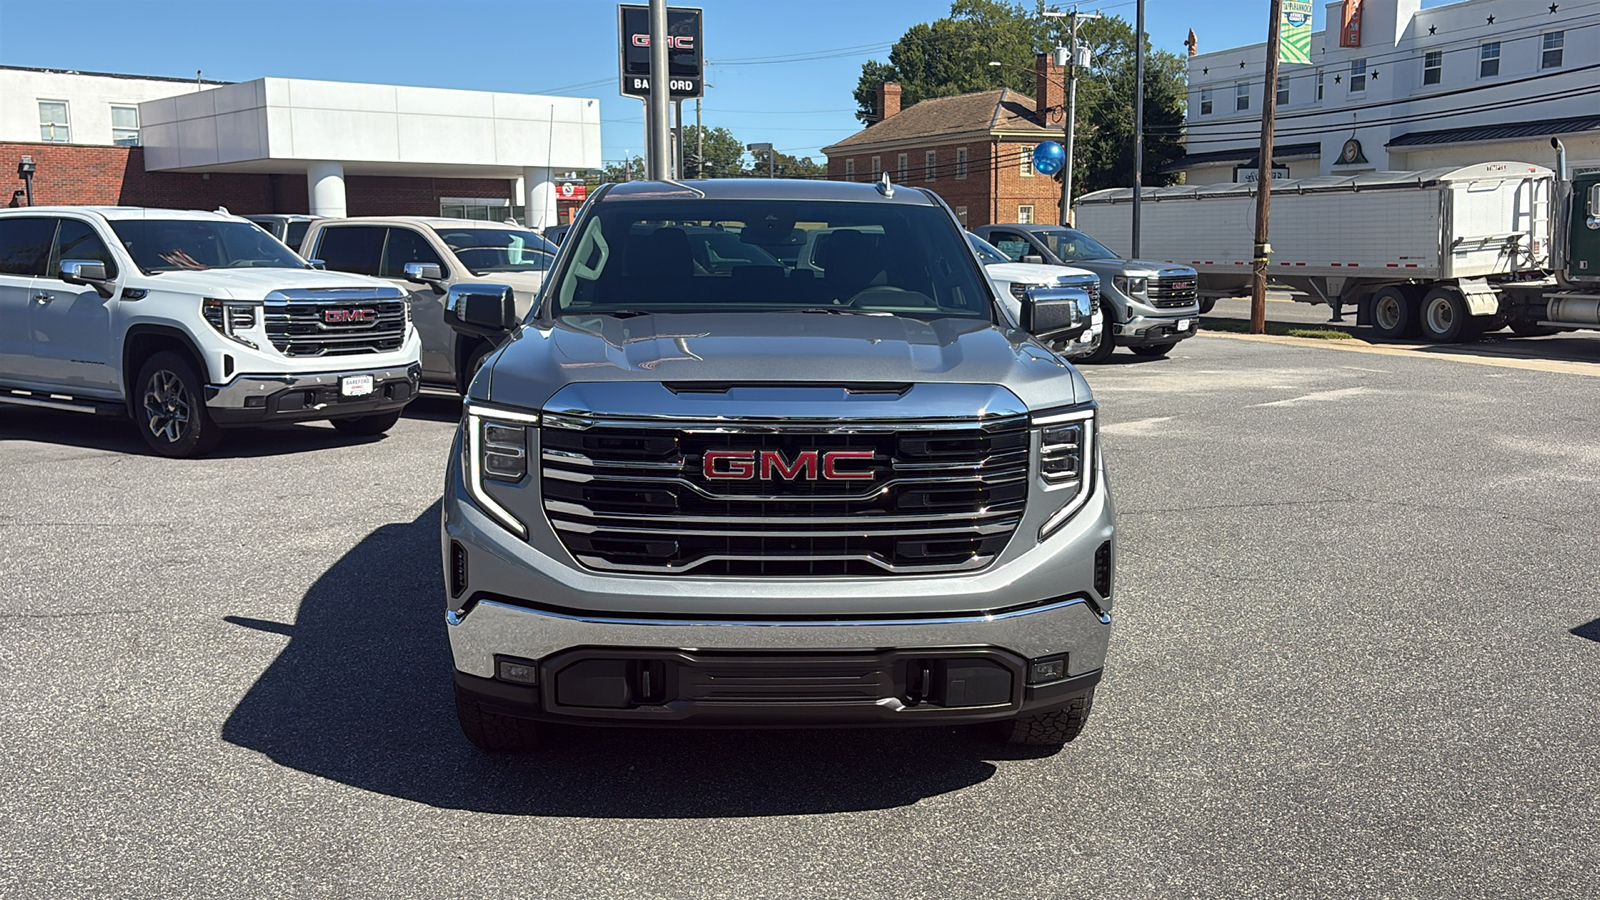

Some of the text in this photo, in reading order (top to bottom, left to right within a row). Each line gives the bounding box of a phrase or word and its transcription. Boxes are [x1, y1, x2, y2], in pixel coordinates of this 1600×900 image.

[632, 33, 694, 49] GC
[634, 79, 693, 91] BAORD
[325, 309, 375, 322] GMC
[702, 449, 876, 481] GMC
